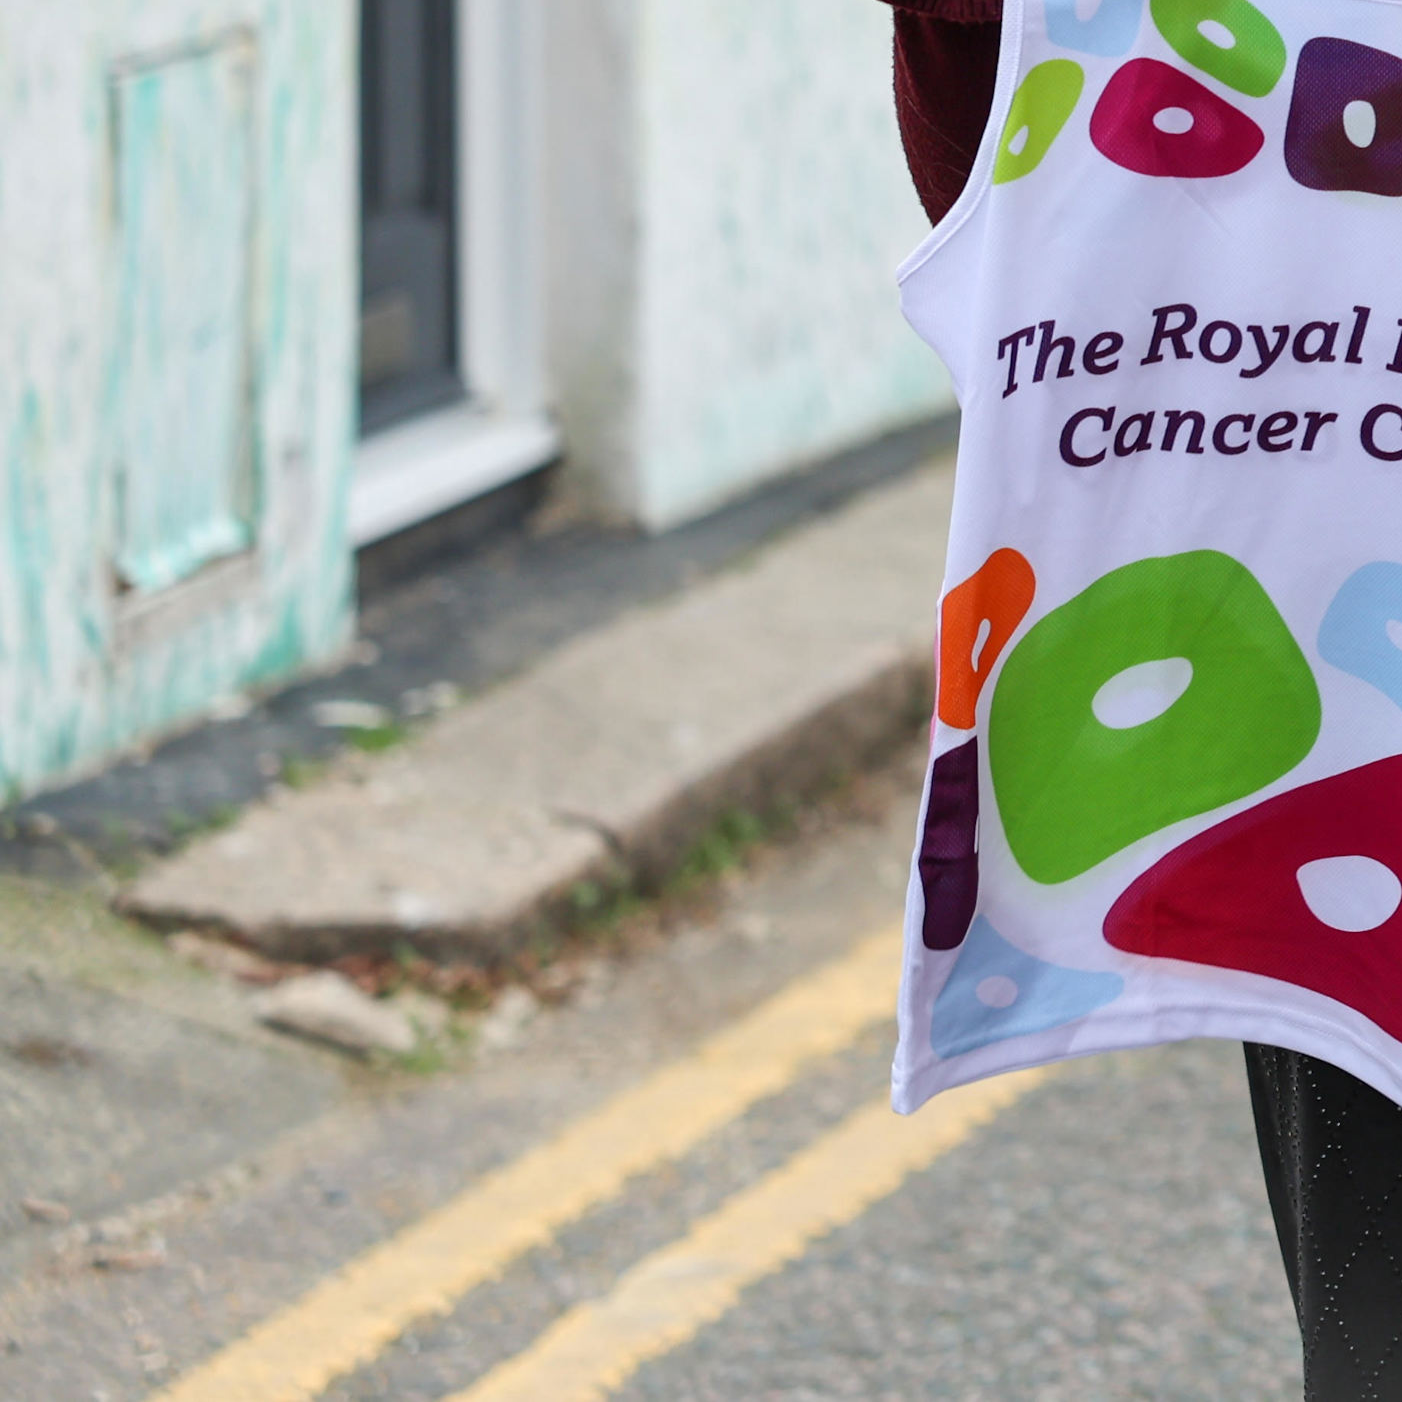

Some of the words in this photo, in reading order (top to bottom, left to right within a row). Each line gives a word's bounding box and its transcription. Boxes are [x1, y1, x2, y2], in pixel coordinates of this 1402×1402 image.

[997, 319, 1125, 400] The
[1139, 303, 1372, 379] Royal
[1058, 404, 1339, 468] Cancer
